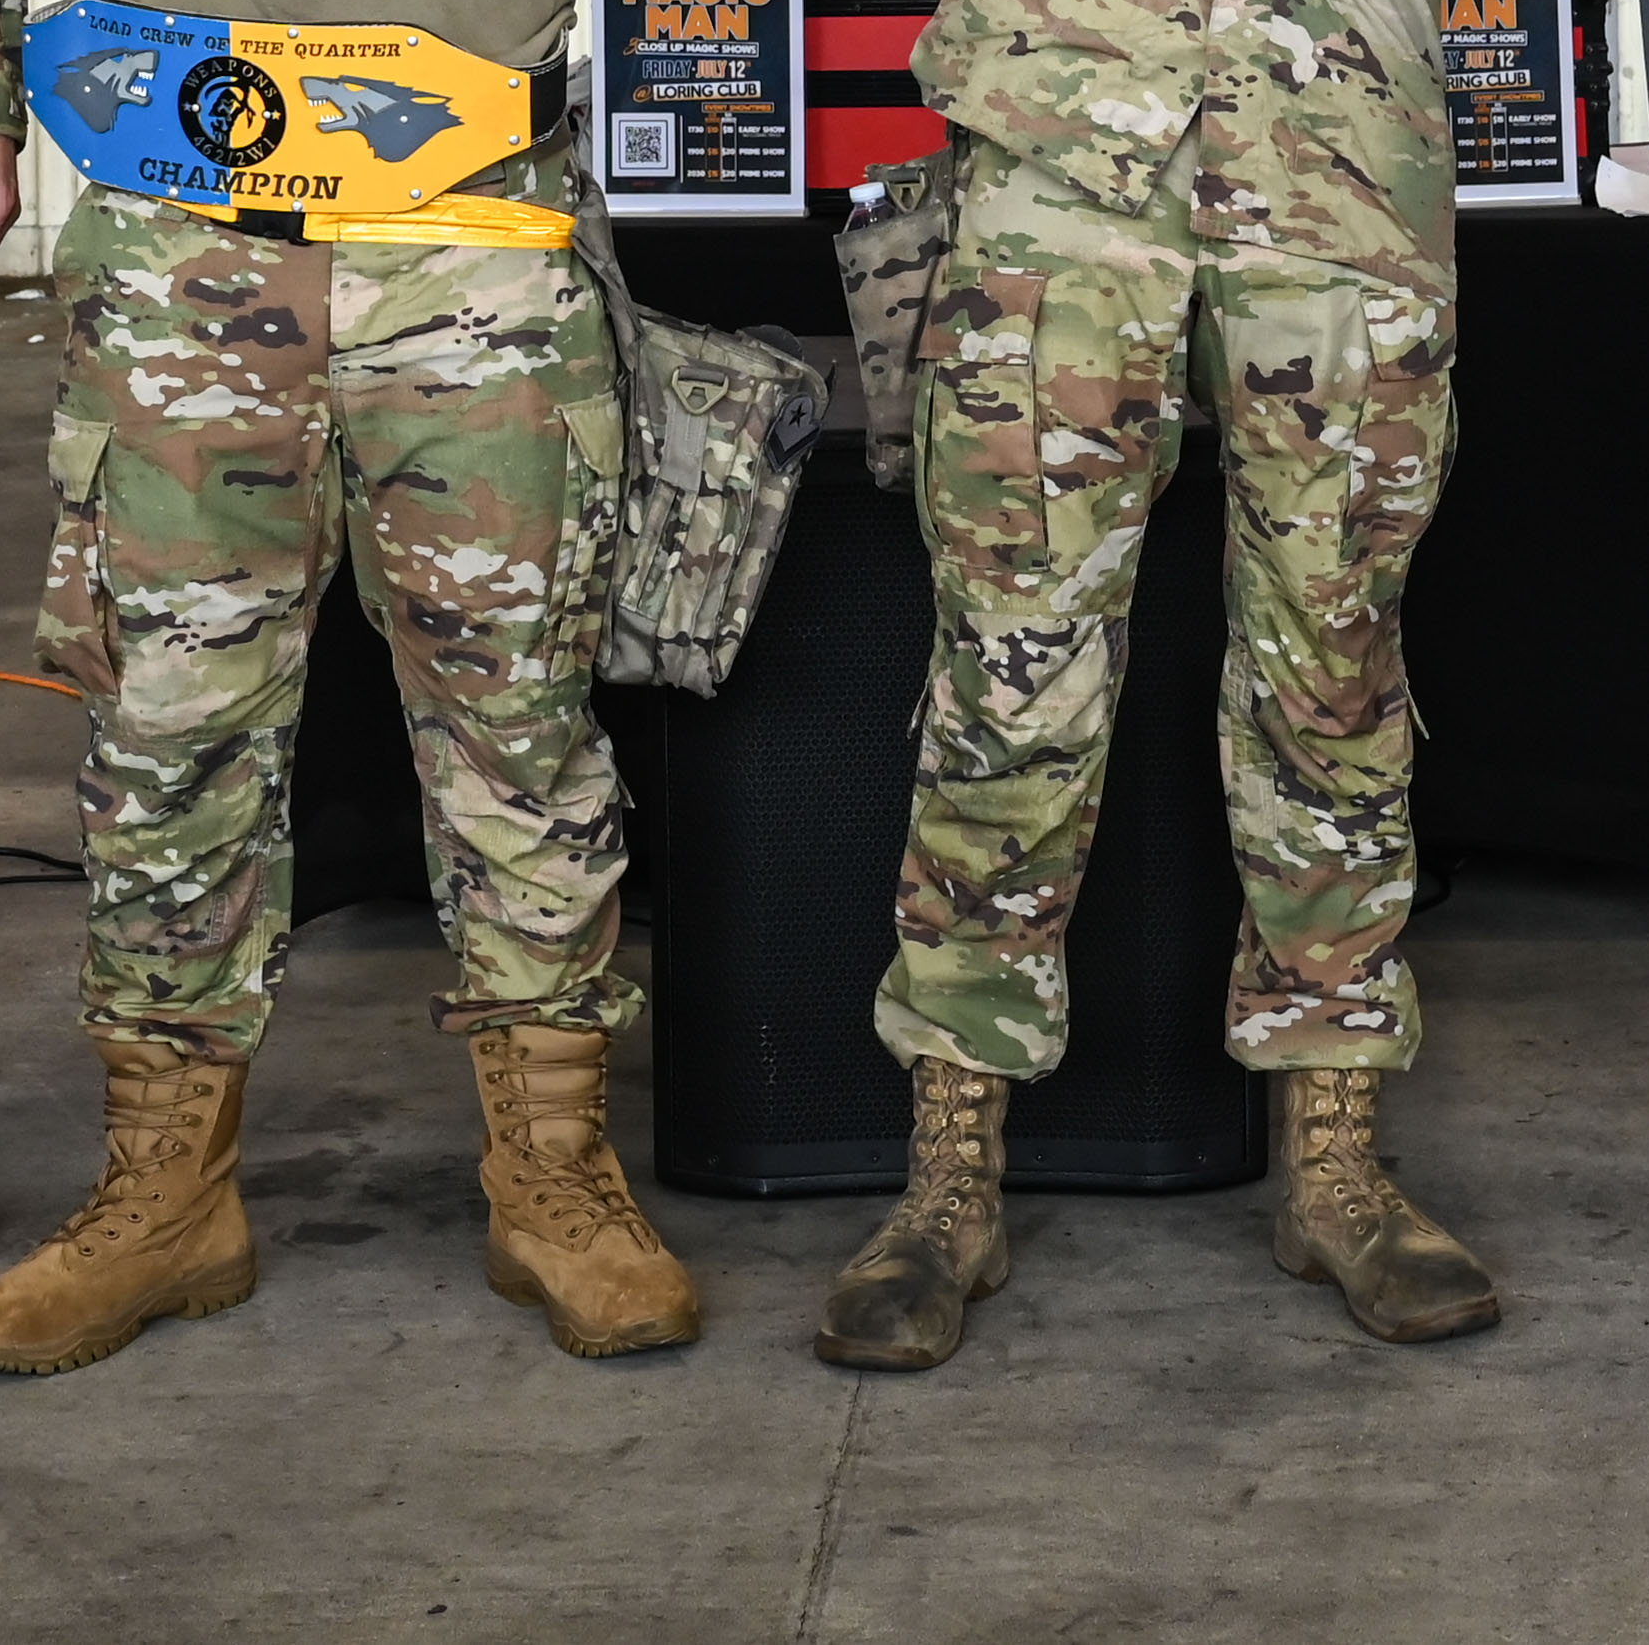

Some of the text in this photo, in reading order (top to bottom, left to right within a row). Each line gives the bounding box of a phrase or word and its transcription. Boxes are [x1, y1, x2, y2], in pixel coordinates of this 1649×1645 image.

[645, 5, 749, 40] MAN
[89, 15, 401, 59] LOAD CREW OF THE QUARTER
[1454, 34, 1525, 43] MAGIC SHOWS
[638, 42, 756, 54] CLOSE UP MAGIC SHOWS
[642, 59, 692, 78] FRIDAY
[695, 59, 727, 78] JULY
[1464, 49, 1496, 69] JULY
[184, 59, 277, 98] WEAPONS
[1447, 72, 1526, 88] RING CLUB
[656, 85, 713, 98] LORING
[717, 84, 757, 96] CLUB
[139, 157, 343, 200] CHAMPION
